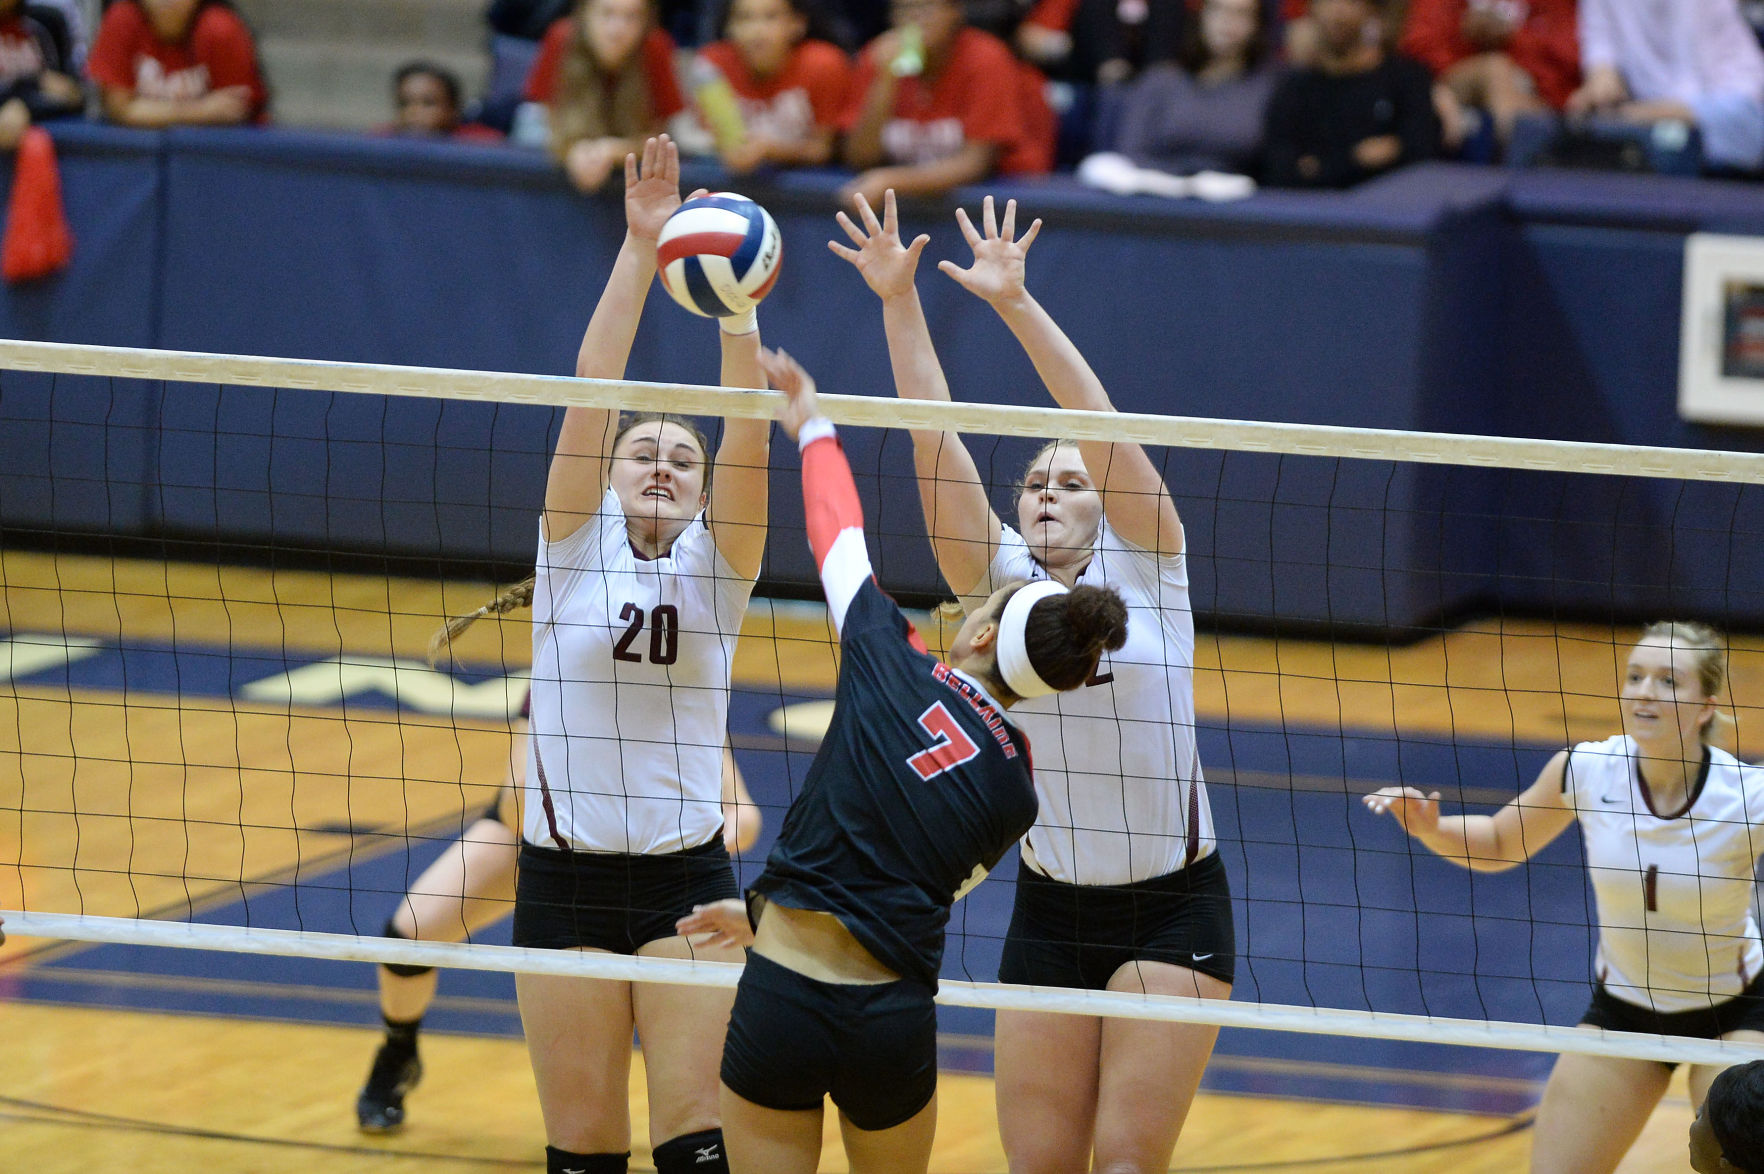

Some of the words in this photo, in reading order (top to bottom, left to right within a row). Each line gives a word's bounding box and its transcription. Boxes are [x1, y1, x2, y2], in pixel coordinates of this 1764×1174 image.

[612, 601, 679, 665] 20
[906, 700, 981, 782] 7
[931, 661, 1018, 759] BELLAIRE
[1644, 864, 1658, 912] 1
